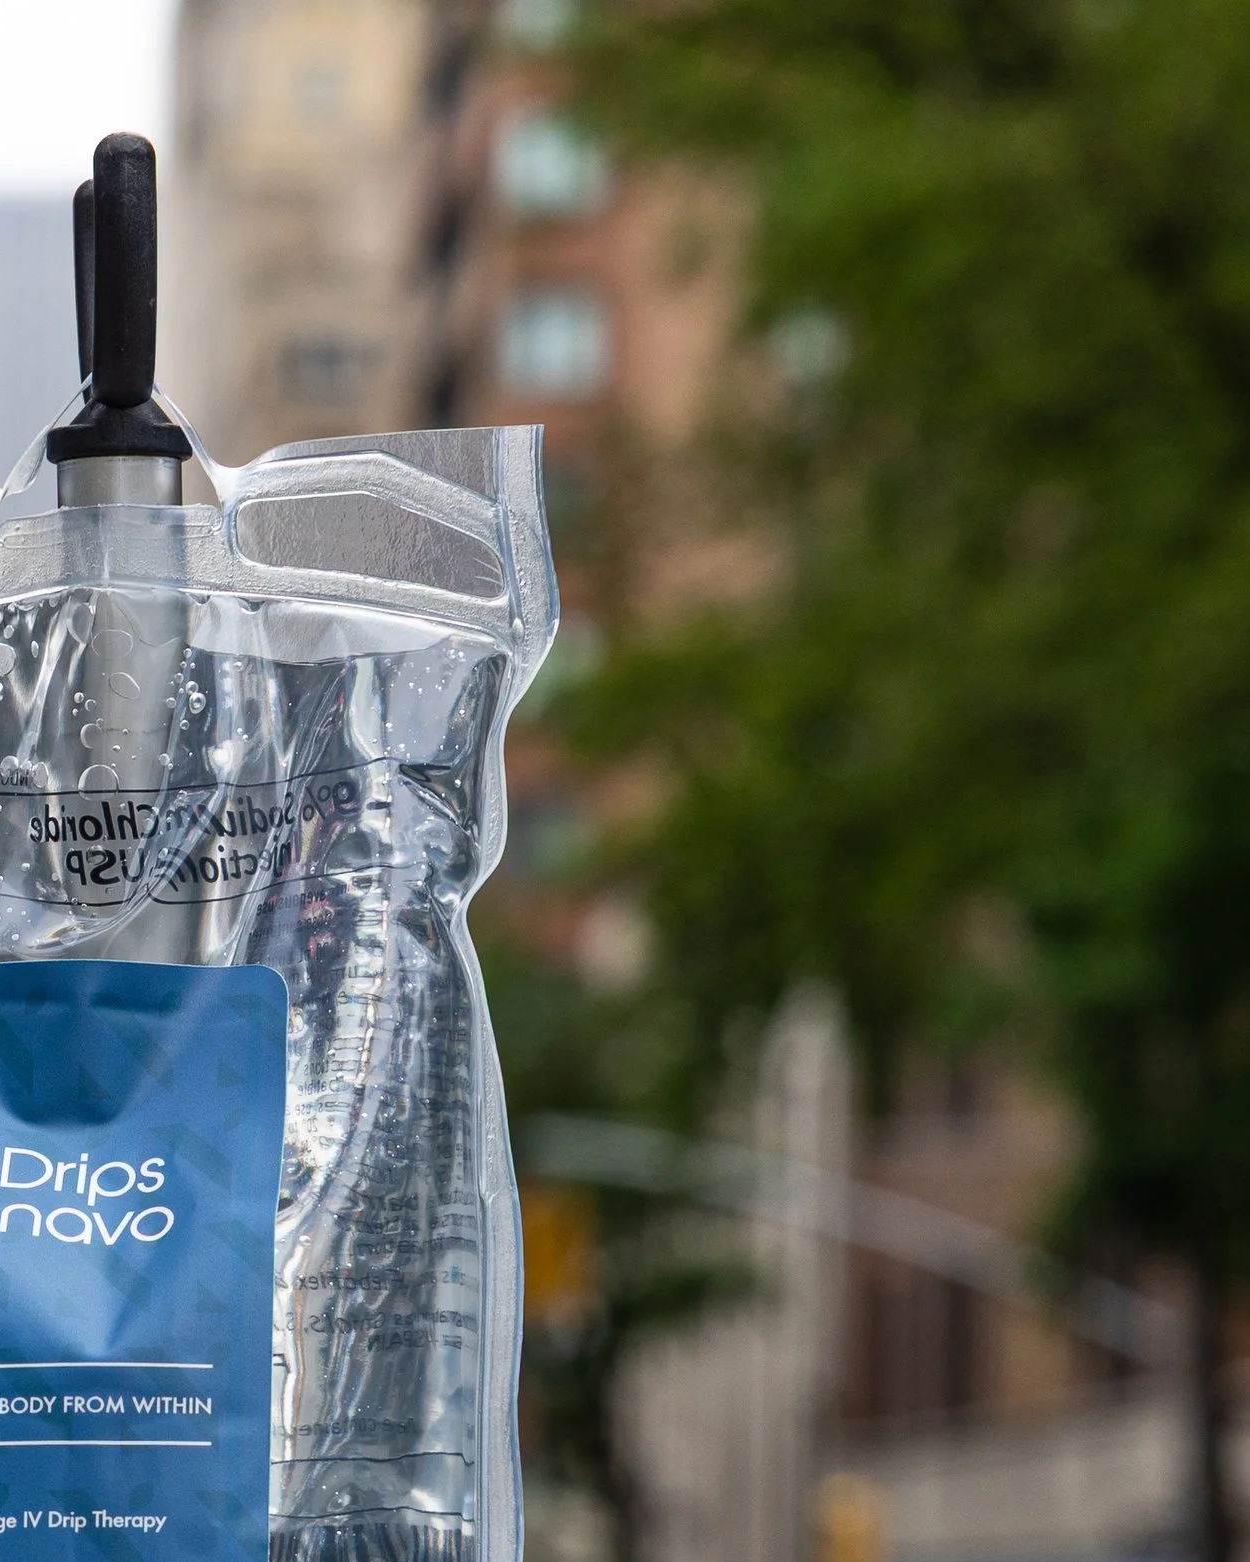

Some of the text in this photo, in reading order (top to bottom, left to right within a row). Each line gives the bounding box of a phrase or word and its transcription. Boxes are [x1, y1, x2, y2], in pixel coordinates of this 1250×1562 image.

[0, 1147, 165, 1206] Drips
[0, 1204, 174, 1246] navo
[0, 1396, 56, 1414] BODY
[63, 1396, 125, 1413] FROM
[132, 1396, 212, 1415] WITHIN
[23, 1511, 43, 1529] IV
[48, 1511, 87, 1534] Drip
[92, 1509, 167, 1533] Therapy
